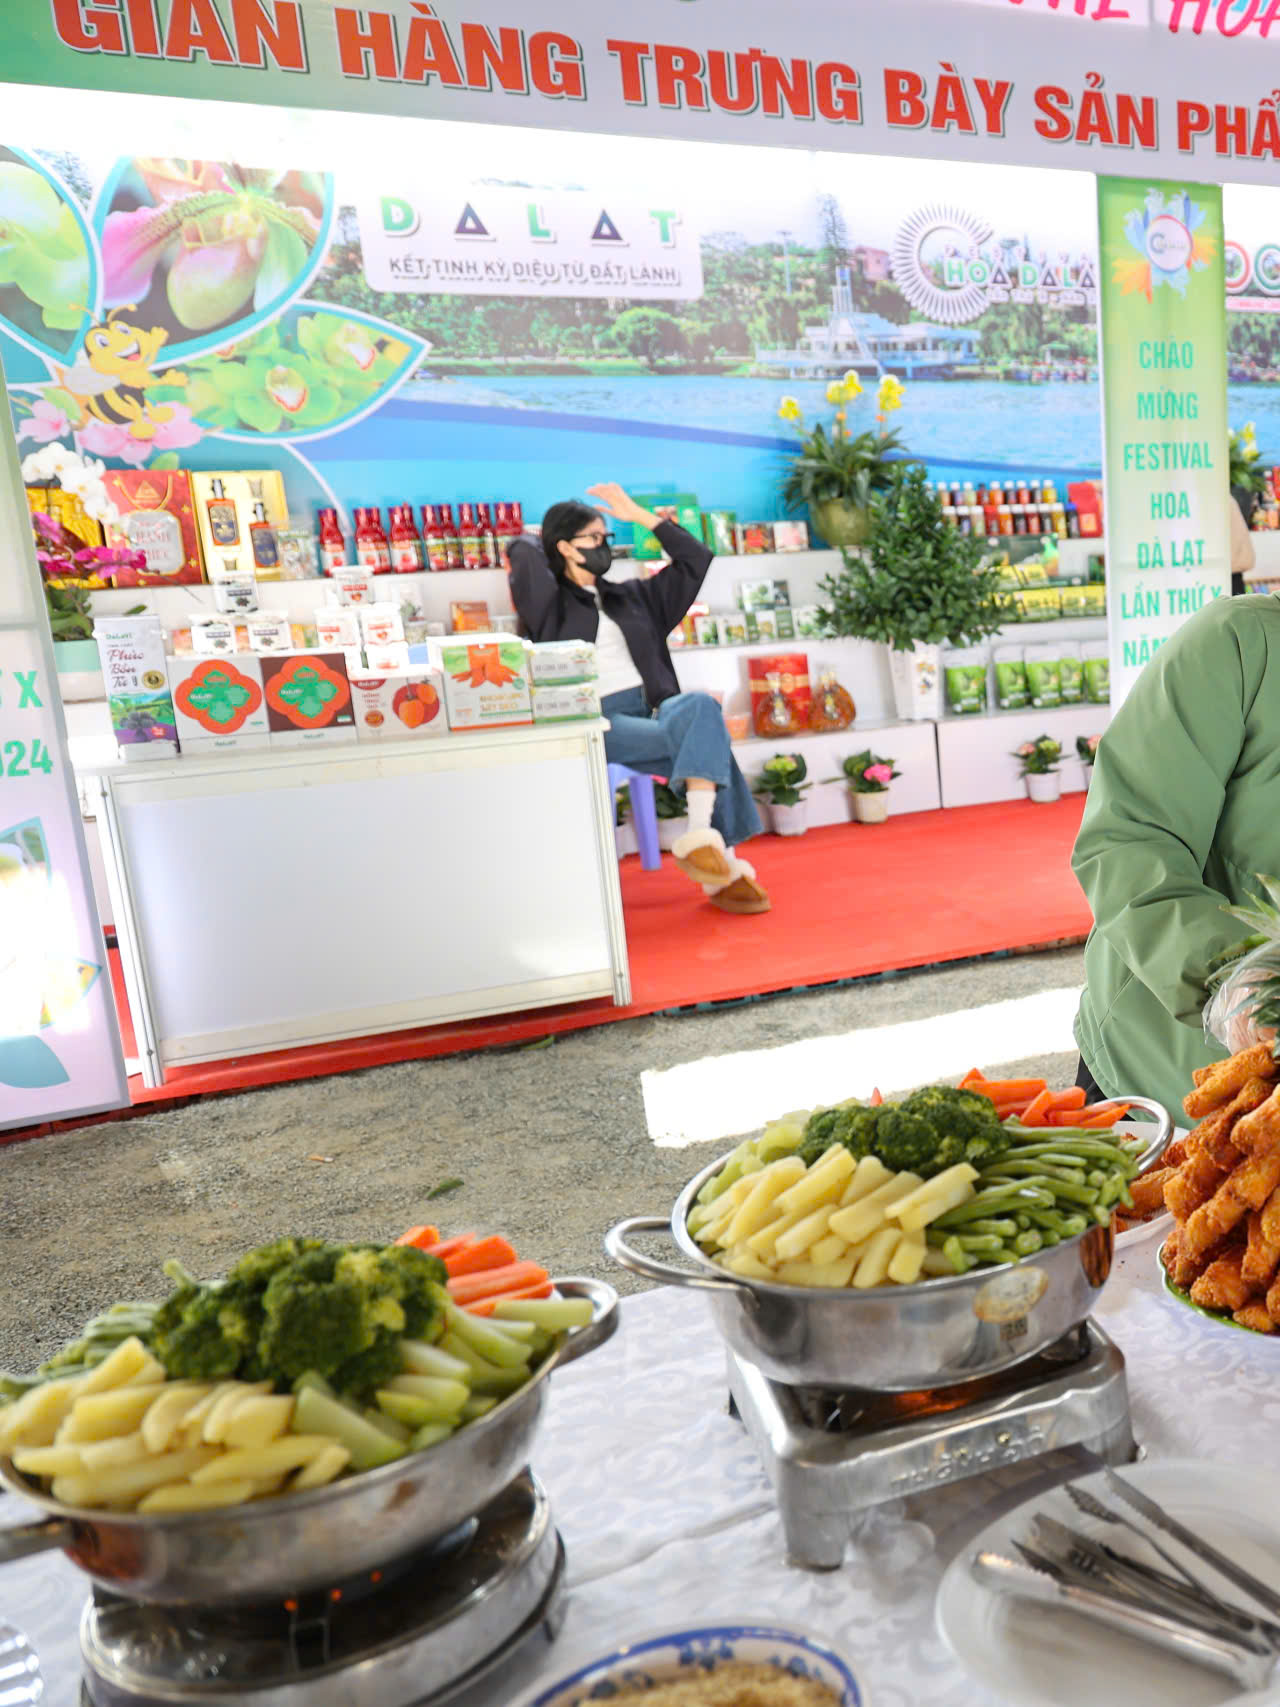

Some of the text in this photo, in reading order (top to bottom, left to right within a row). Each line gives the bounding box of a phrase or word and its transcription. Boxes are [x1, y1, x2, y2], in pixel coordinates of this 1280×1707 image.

[50, 0, 306, 71] GIAN
[333, 0, 586, 99] HÀNG
[606, 38, 862, 124] TRƯNG
[883, 60, 1014, 138] BÀY
[1033, 70, 1158, 150] SẢN
[432, 258, 479, 275] TINH
[1138, 338, 1194, 369] CHÀO
[1136, 387, 1199, 421] MỪNG
[1122, 442, 1214, 471] FESTIVAL
[1150, 491, 1191, 520] HOA
[1137, 536, 1205, 573] ĐÀ LẠT
[1121, 580, 1160, 619] LẦN
[1166, 580, 1206, 616] THỨ
[13, 670, 44, 709] X
[0, 739, 54, 777] 24
